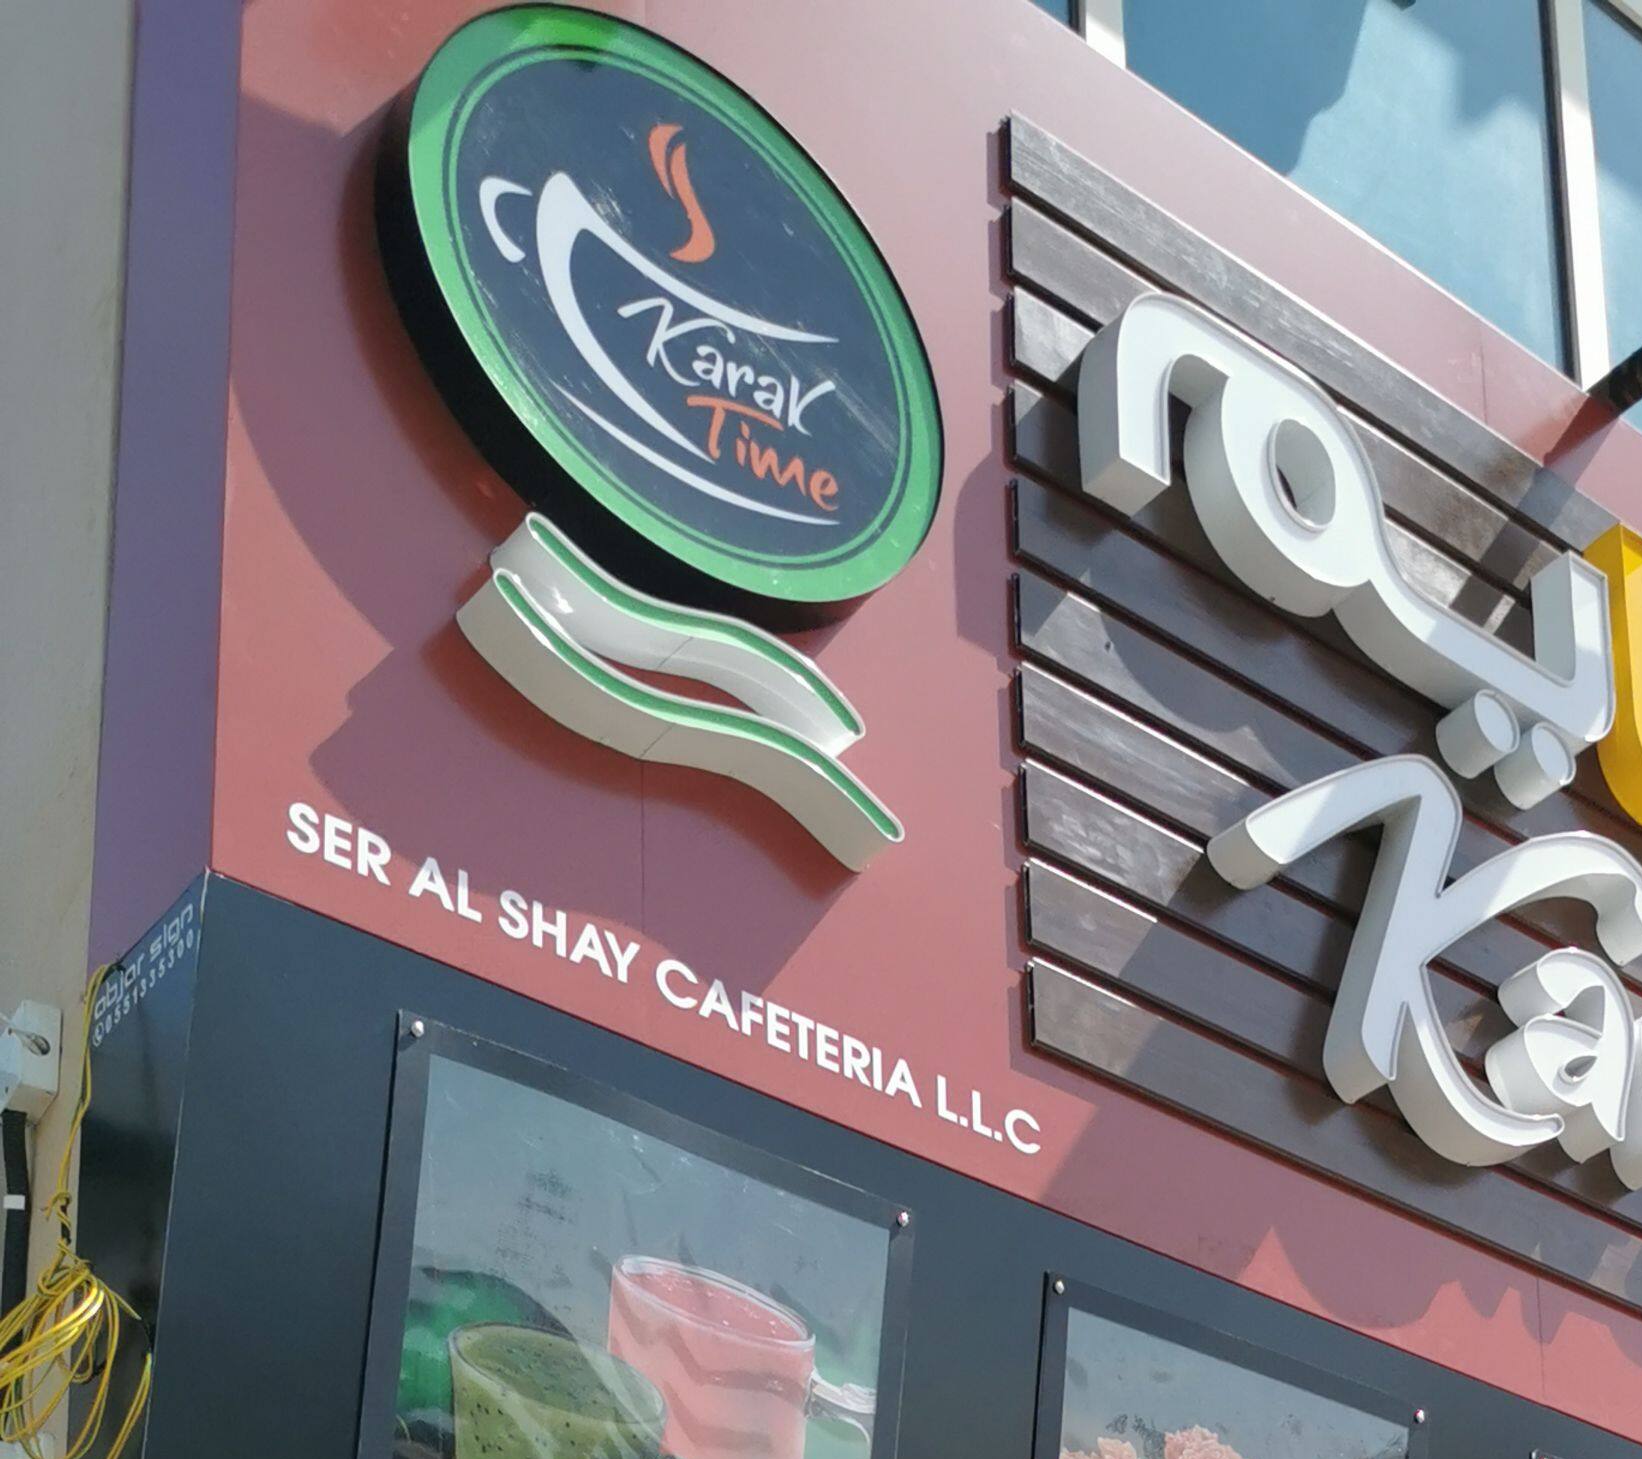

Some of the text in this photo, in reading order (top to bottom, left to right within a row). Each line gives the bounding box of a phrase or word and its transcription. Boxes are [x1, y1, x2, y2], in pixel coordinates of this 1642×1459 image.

[617, 297, 836, 440] Karak
[687, 393, 840, 512] Time
[286, 801, 1042, 1158] SER AL SHAY CAFETERIA L.L.C
